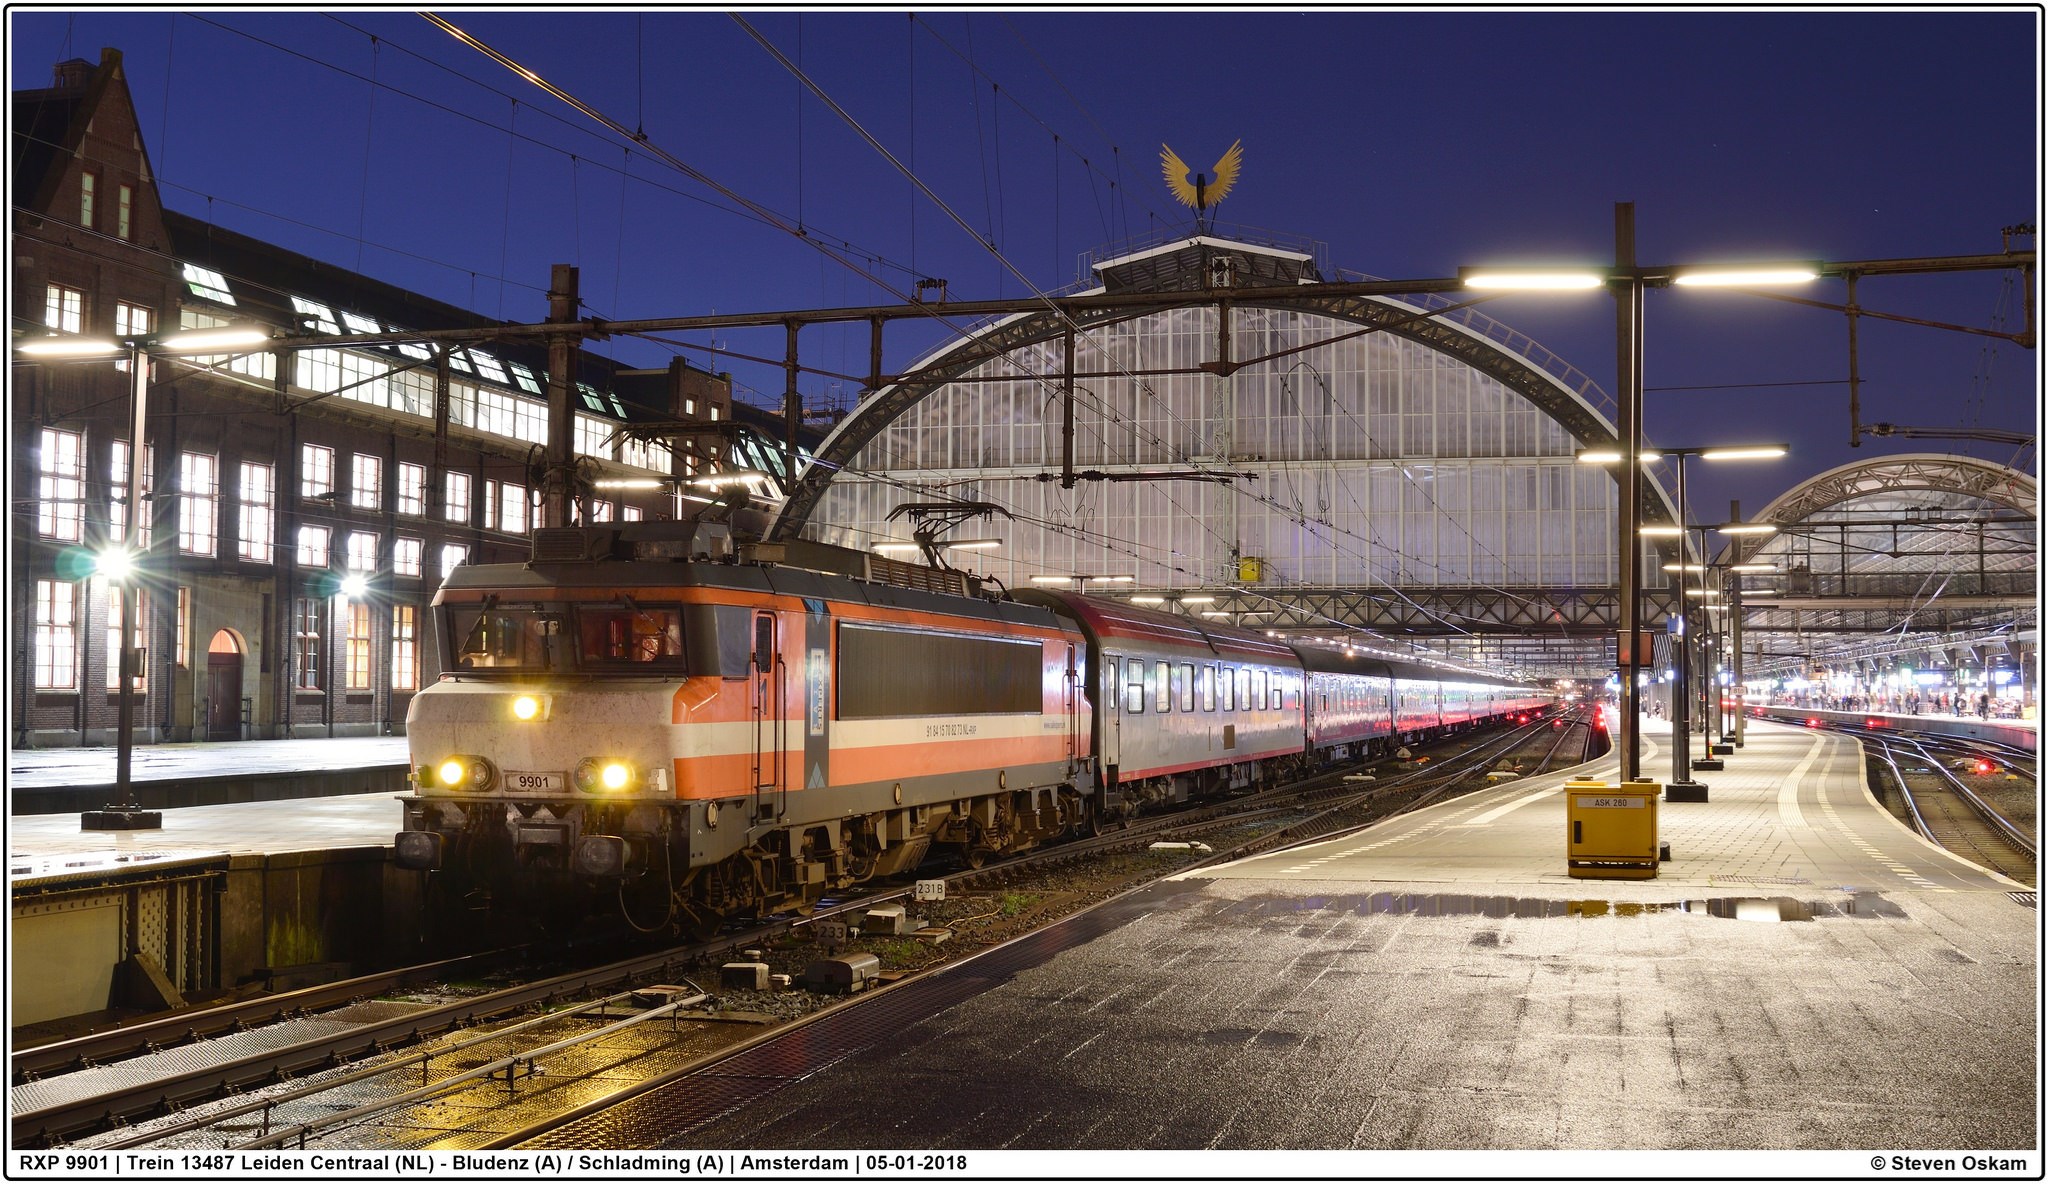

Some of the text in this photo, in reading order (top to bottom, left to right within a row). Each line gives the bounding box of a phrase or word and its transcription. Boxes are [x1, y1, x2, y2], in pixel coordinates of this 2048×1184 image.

[519, 776, 549, 788] 9901
[1595, 798, 1611, 807] ASK
[918, 883, 943, 894] 231B
[820, 926, 844, 939] 233
